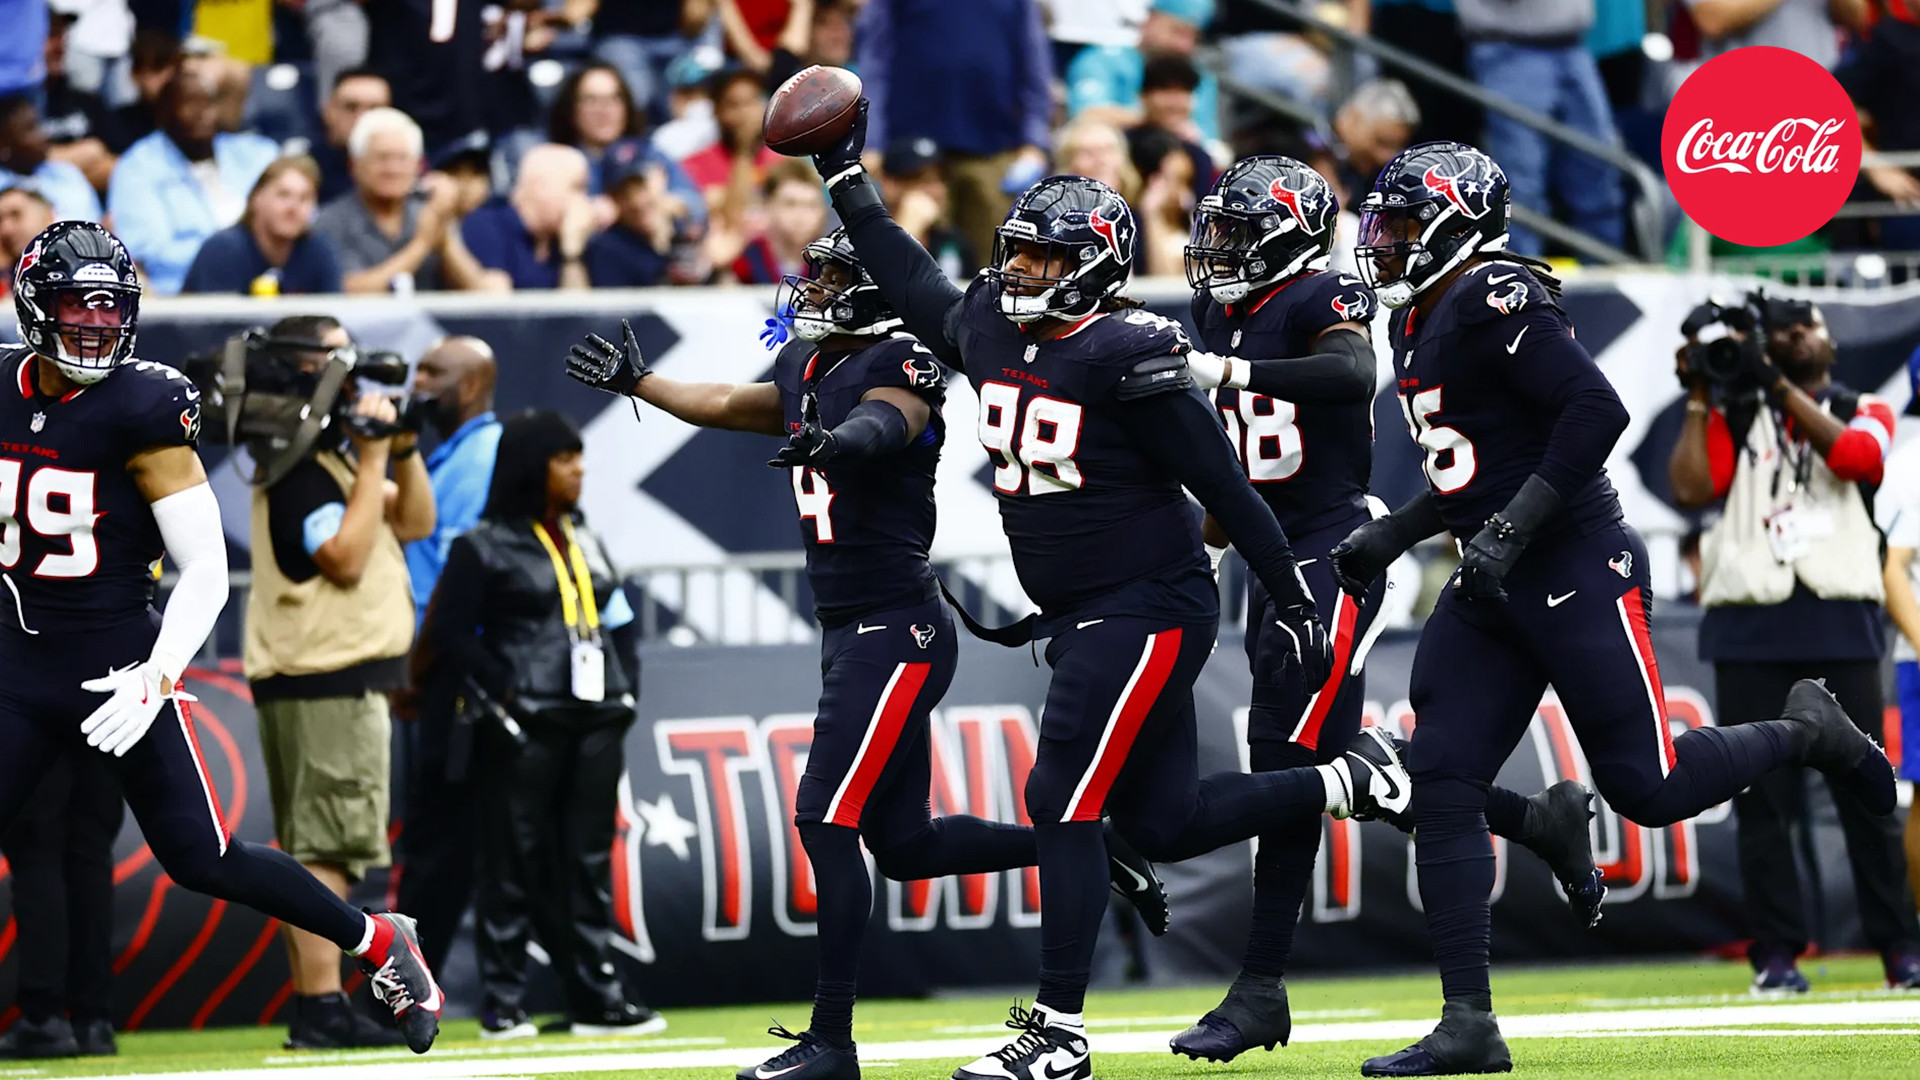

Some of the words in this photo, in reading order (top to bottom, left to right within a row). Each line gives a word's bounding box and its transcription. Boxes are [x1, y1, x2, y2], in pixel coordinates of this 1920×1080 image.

[1009, 222, 1032, 231] TEXANS
[1001, 367, 1049, 390] TEXANS
[978, 378, 1085, 497] 98
[1, 441, 60, 460] TEXANS
[791, 465, 839, 545] 4
